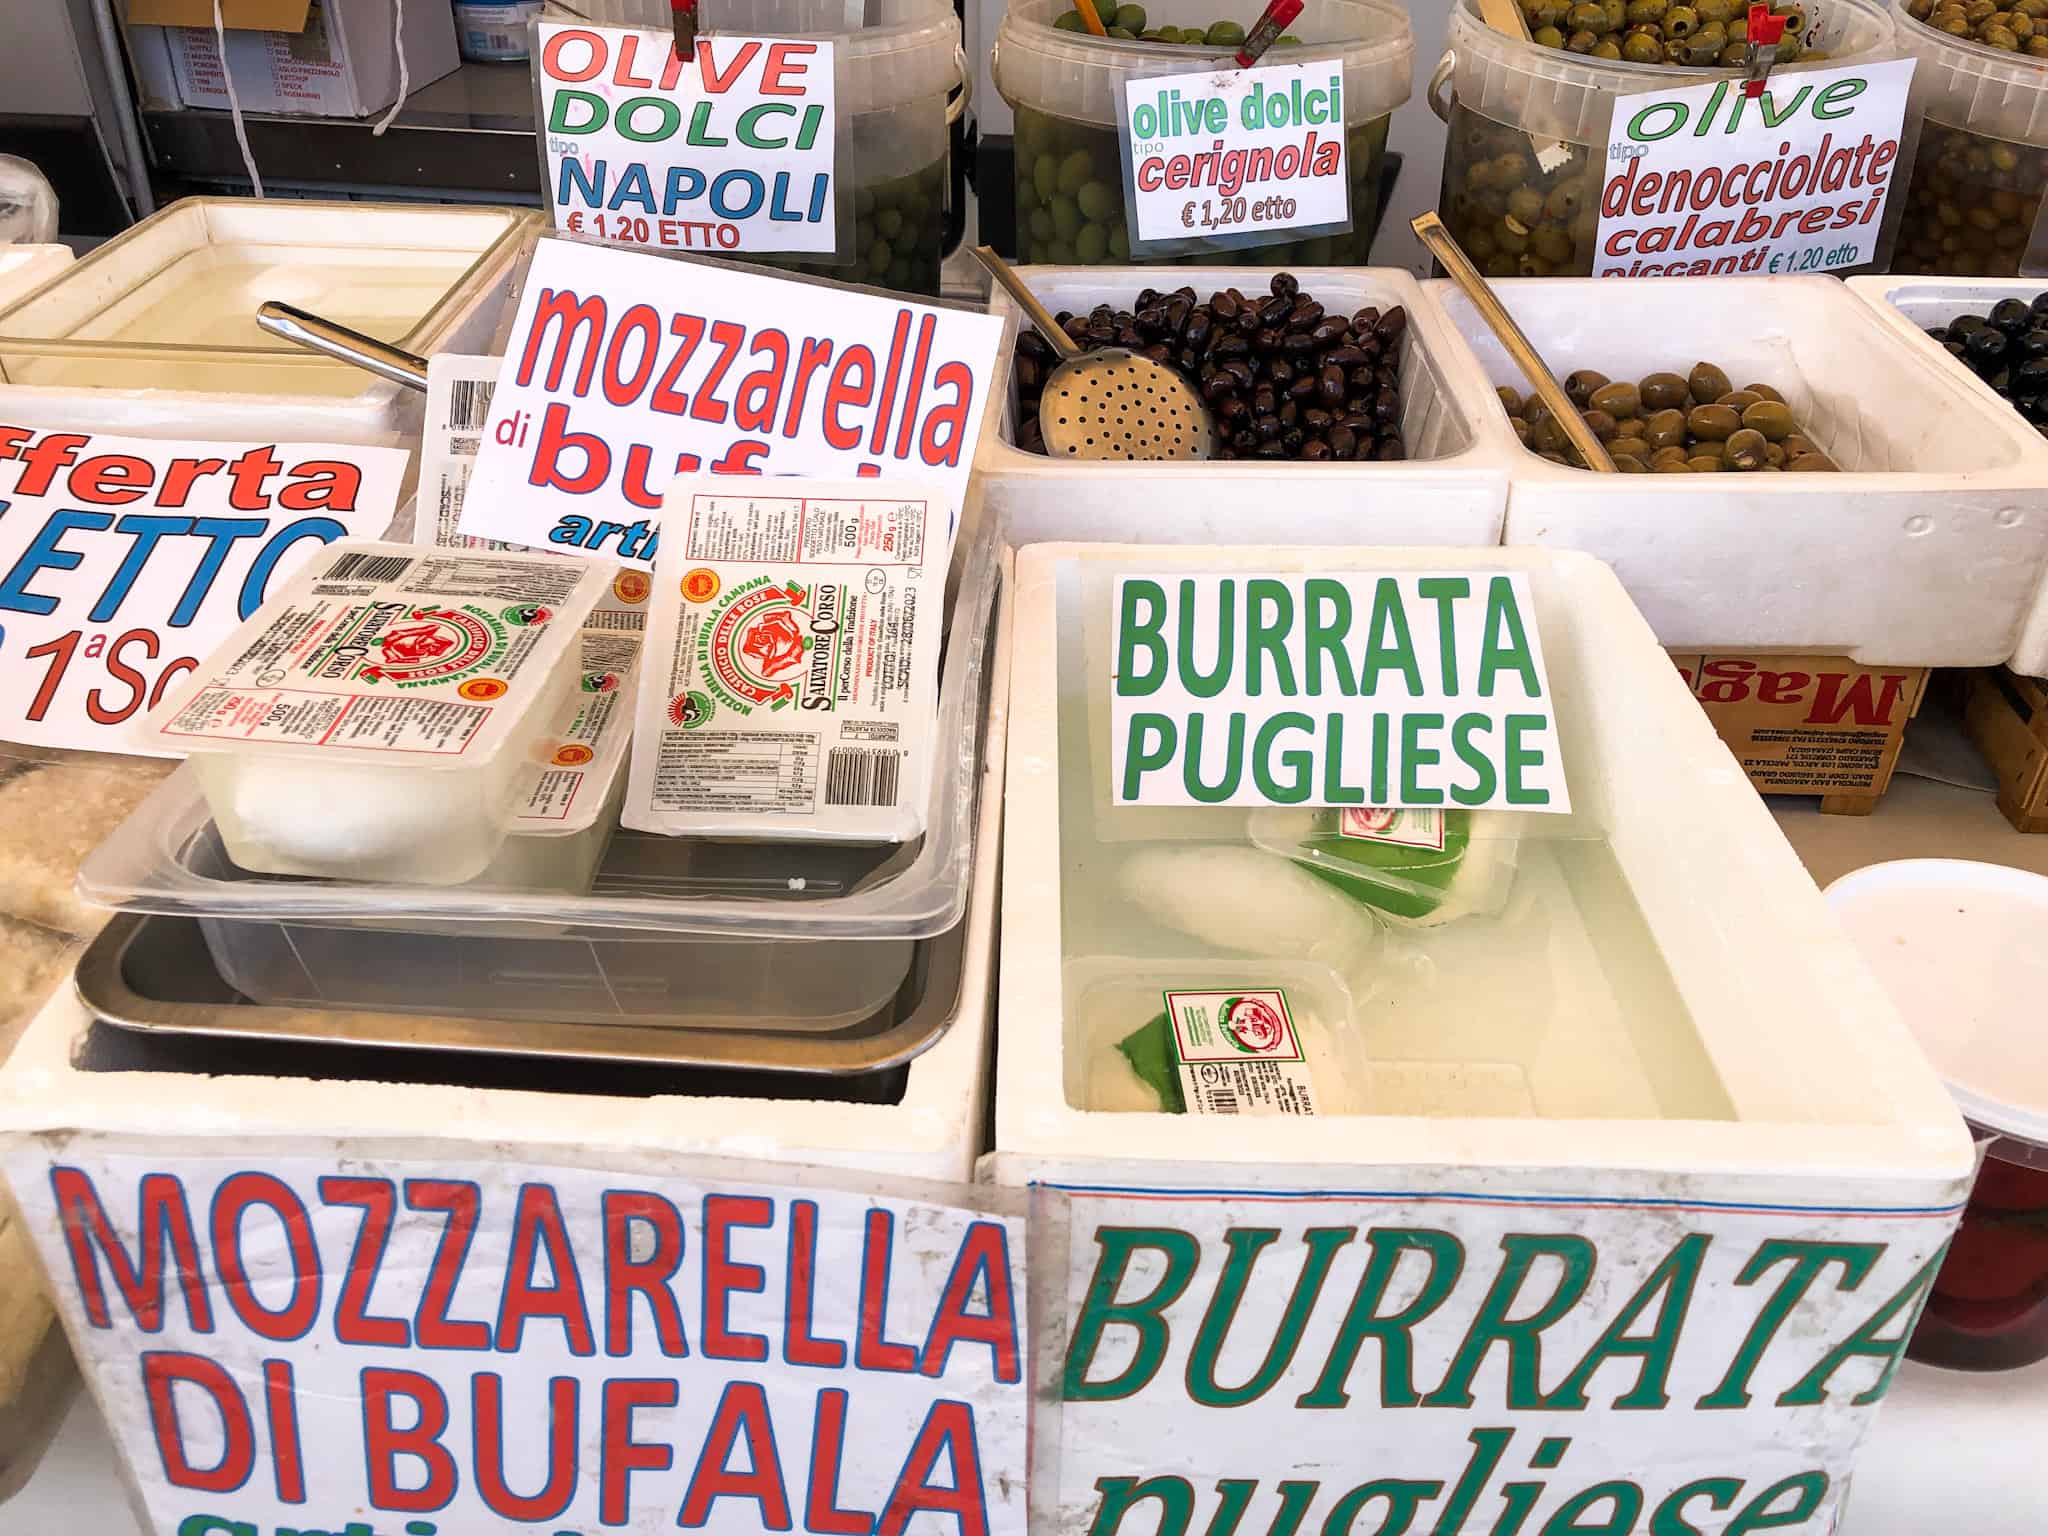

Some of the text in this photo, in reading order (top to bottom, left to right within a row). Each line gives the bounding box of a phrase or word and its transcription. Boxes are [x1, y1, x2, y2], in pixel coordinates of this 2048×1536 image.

[542, 29, 818, 96] OLIVE
[548, 89, 824, 150] DOLCI
[1133, 76, 1340, 139] olive dolci
[1626, 78, 1868, 141] olive
[549, 137, 579, 156] tipo
[1134, 140, 1164, 156] tipo
[1138, 131, 1340, 196] cerignola
[1609, 143, 1649, 162] tipo
[558, 156, 829, 222] NAPOLI
[1601, 133, 1897, 218] denocciolate
[567, 212, 740, 248] € 1.20 ETTO
[1182, 196, 1296, 229] € 1,20 etto
[1604, 187, 1885, 256] calabresi
[1768, 253, 1780, 274] €
[1787, 248, 1822, 272] 1.20
[1827, 243, 1857, 264] etto
[515, 287, 975, 467] mozzarella
[495, 410, 531, 448] di
[844, 525, 857, 548] 500
[883, 533, 895, 552] 250
[719, 575, 771, 607] CAMPANA
[697, 609, 721, 648] BUFALA
[718, 612, 739, 643] DELLE
[844, 595, 858, 634] Tradizione
[869, 620, 878, 640] ITALY
[697, 650, 708, 661] DI
[842, 636, 853, 655] della
[1116, 576, 1542, 697] BURRATA
[840, 657, 852, 693] perCorso
[866, 647, 875, 677] PRODUCT
[1679, 660, 1907, 726] Mag
[267, 704, 291, 721] 500
[1122, 711, 1550, 805] PUGLIESE
[1297, 1085, 1314, 1116] BURRAT
[51, 1165, 1021, 1384] MOZZARELLA
[1064, 1224, 1950, 1410] BURRATA
[141, 1350, 991, 1536] DI BUFALA
